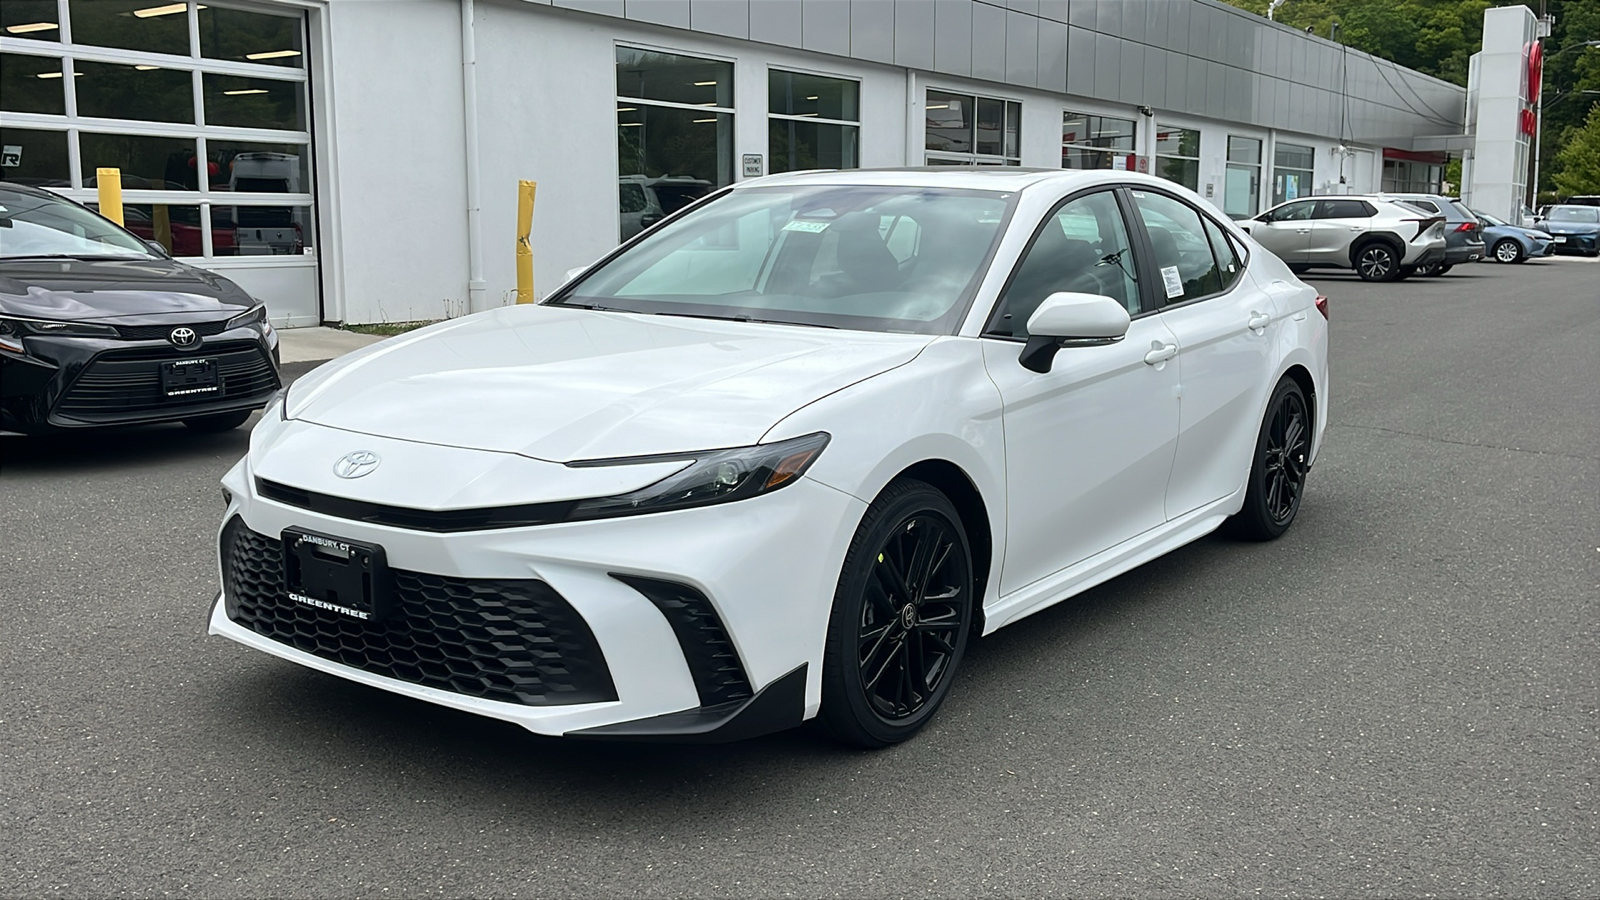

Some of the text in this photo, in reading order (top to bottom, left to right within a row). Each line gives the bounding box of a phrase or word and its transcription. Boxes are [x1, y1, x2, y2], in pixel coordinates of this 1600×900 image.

[744, 157, 761, 165] CUSTOMER
[167, 386, 218, 396] GREENTREE
[302, 534, 350, 552] DANBURY, CT
[288, 592, 369, 620] GREENTREE
